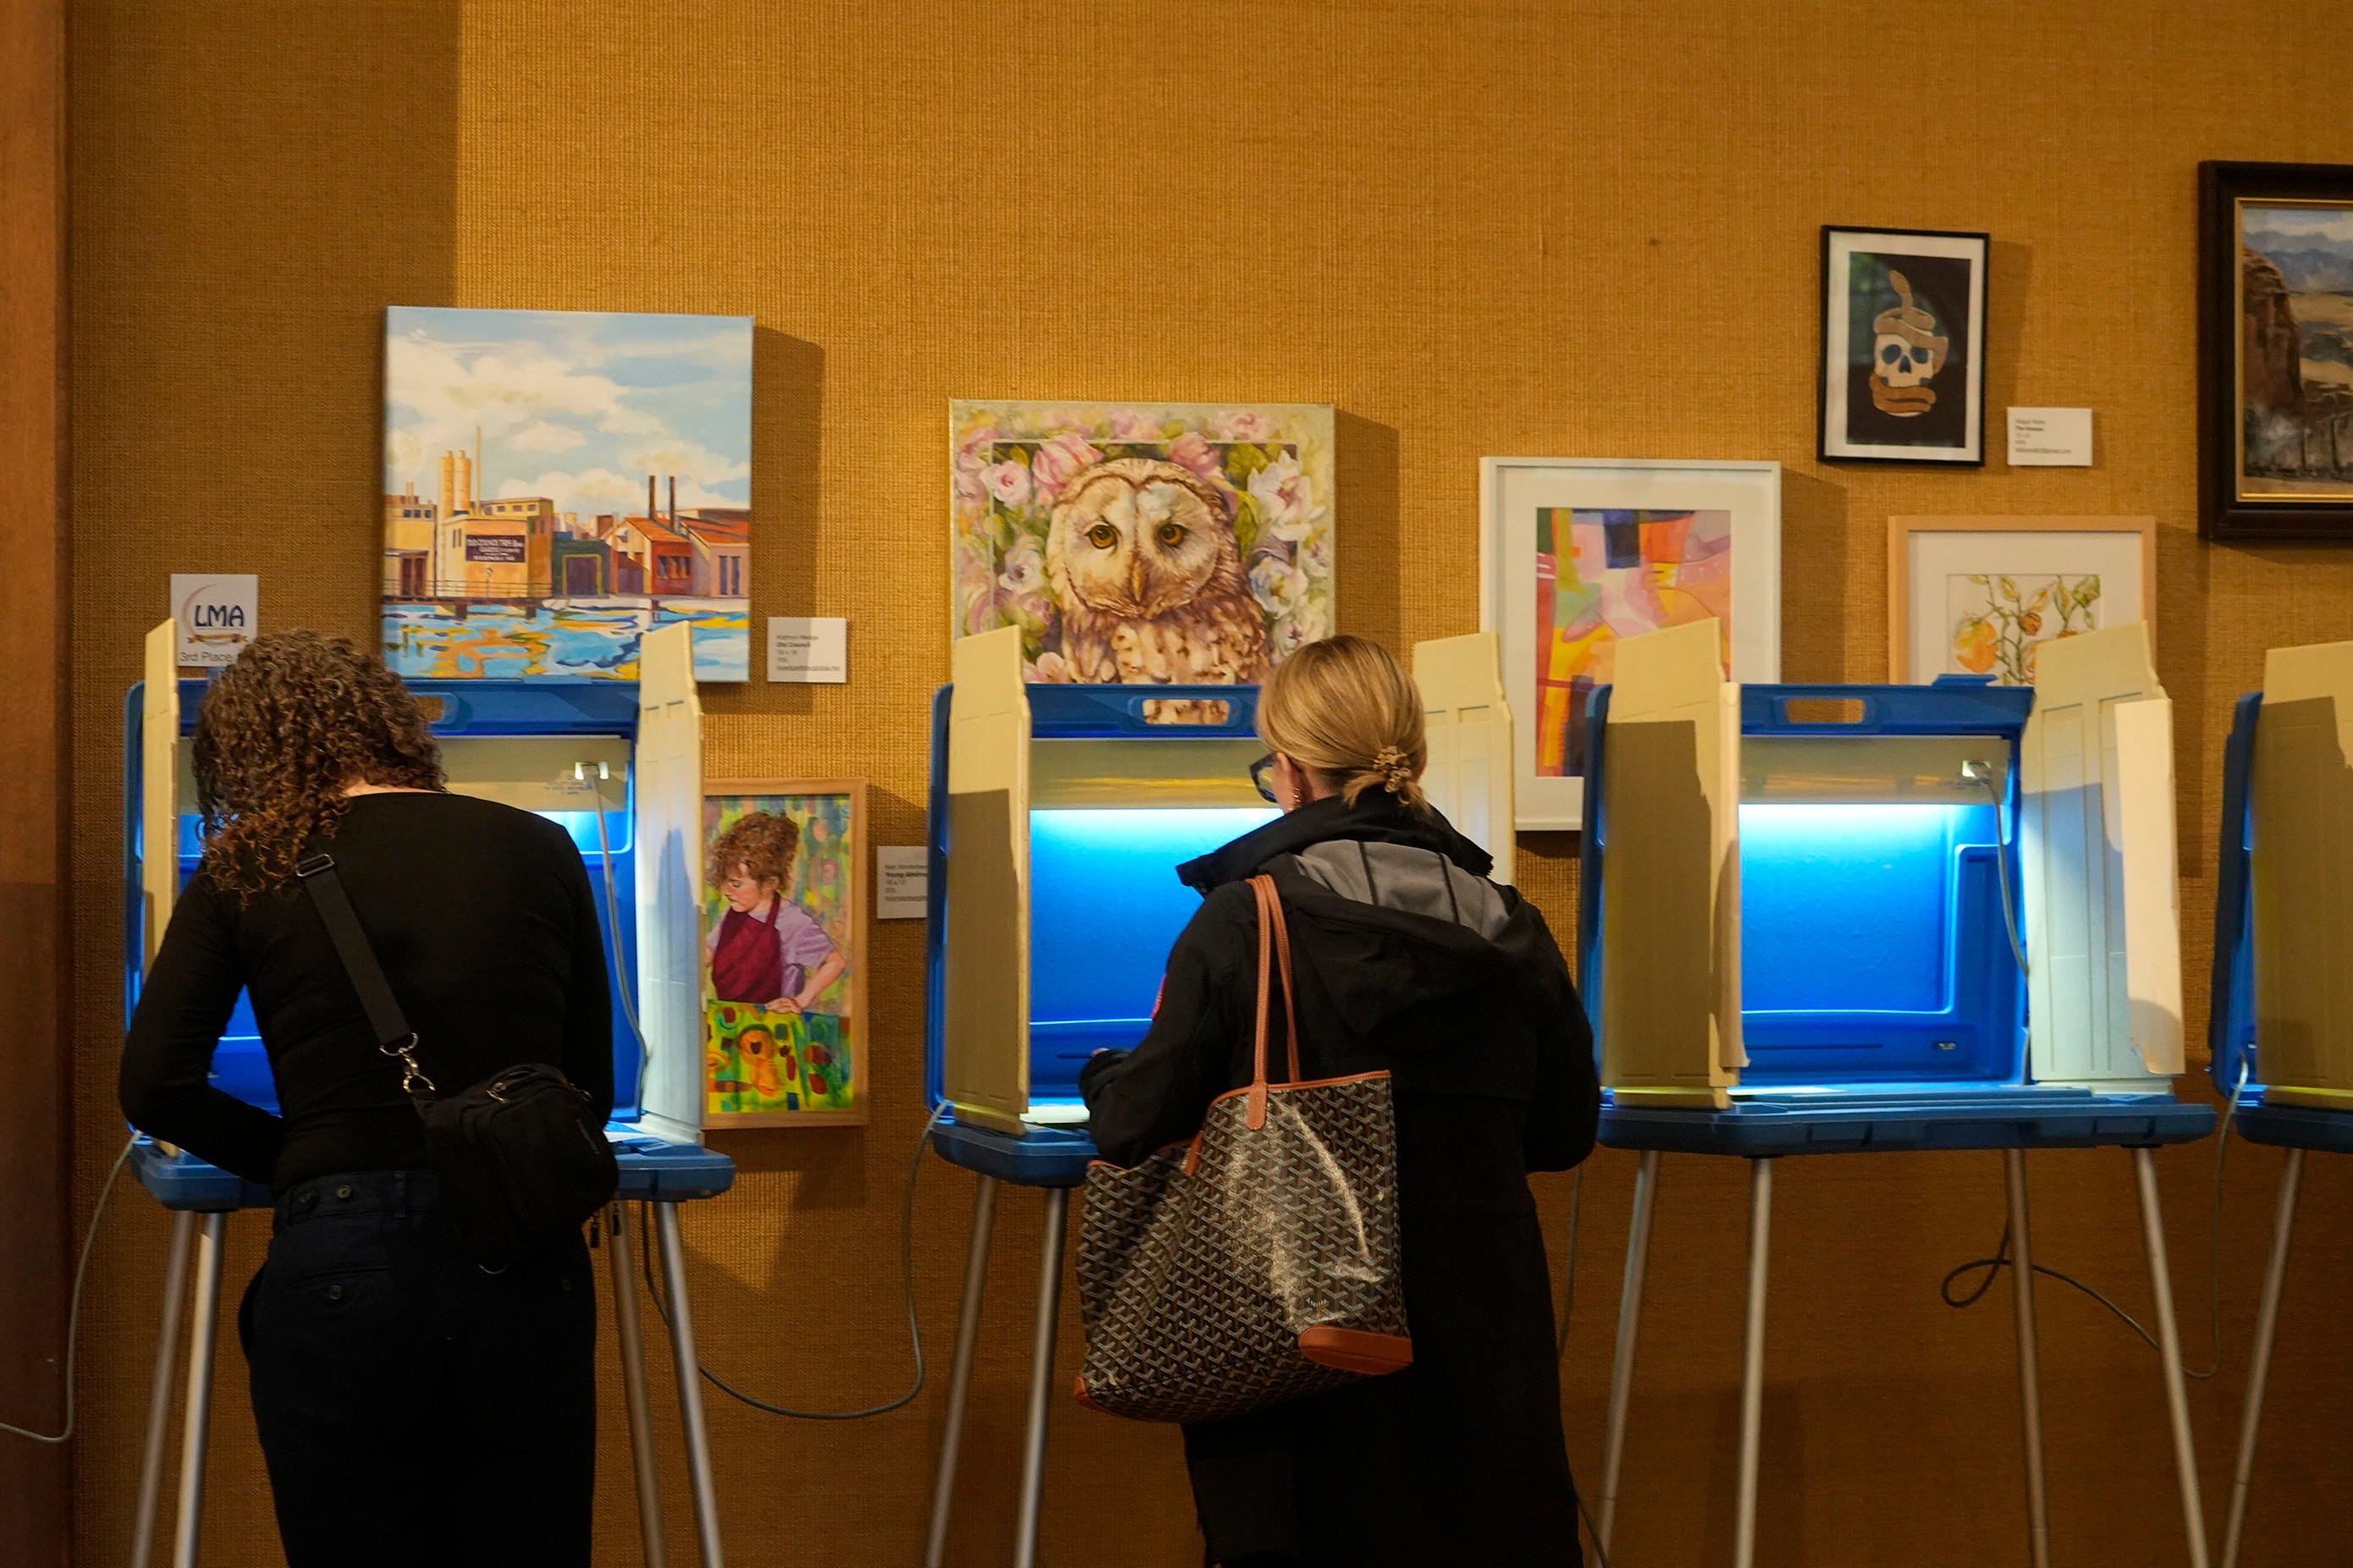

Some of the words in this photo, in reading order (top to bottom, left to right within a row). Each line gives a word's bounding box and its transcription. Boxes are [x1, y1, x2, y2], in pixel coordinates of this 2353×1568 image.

[195, 605, 245, 627] LMA
[179, 652, 198, 662] 3rd
[201, 652, 233, 662] Place
